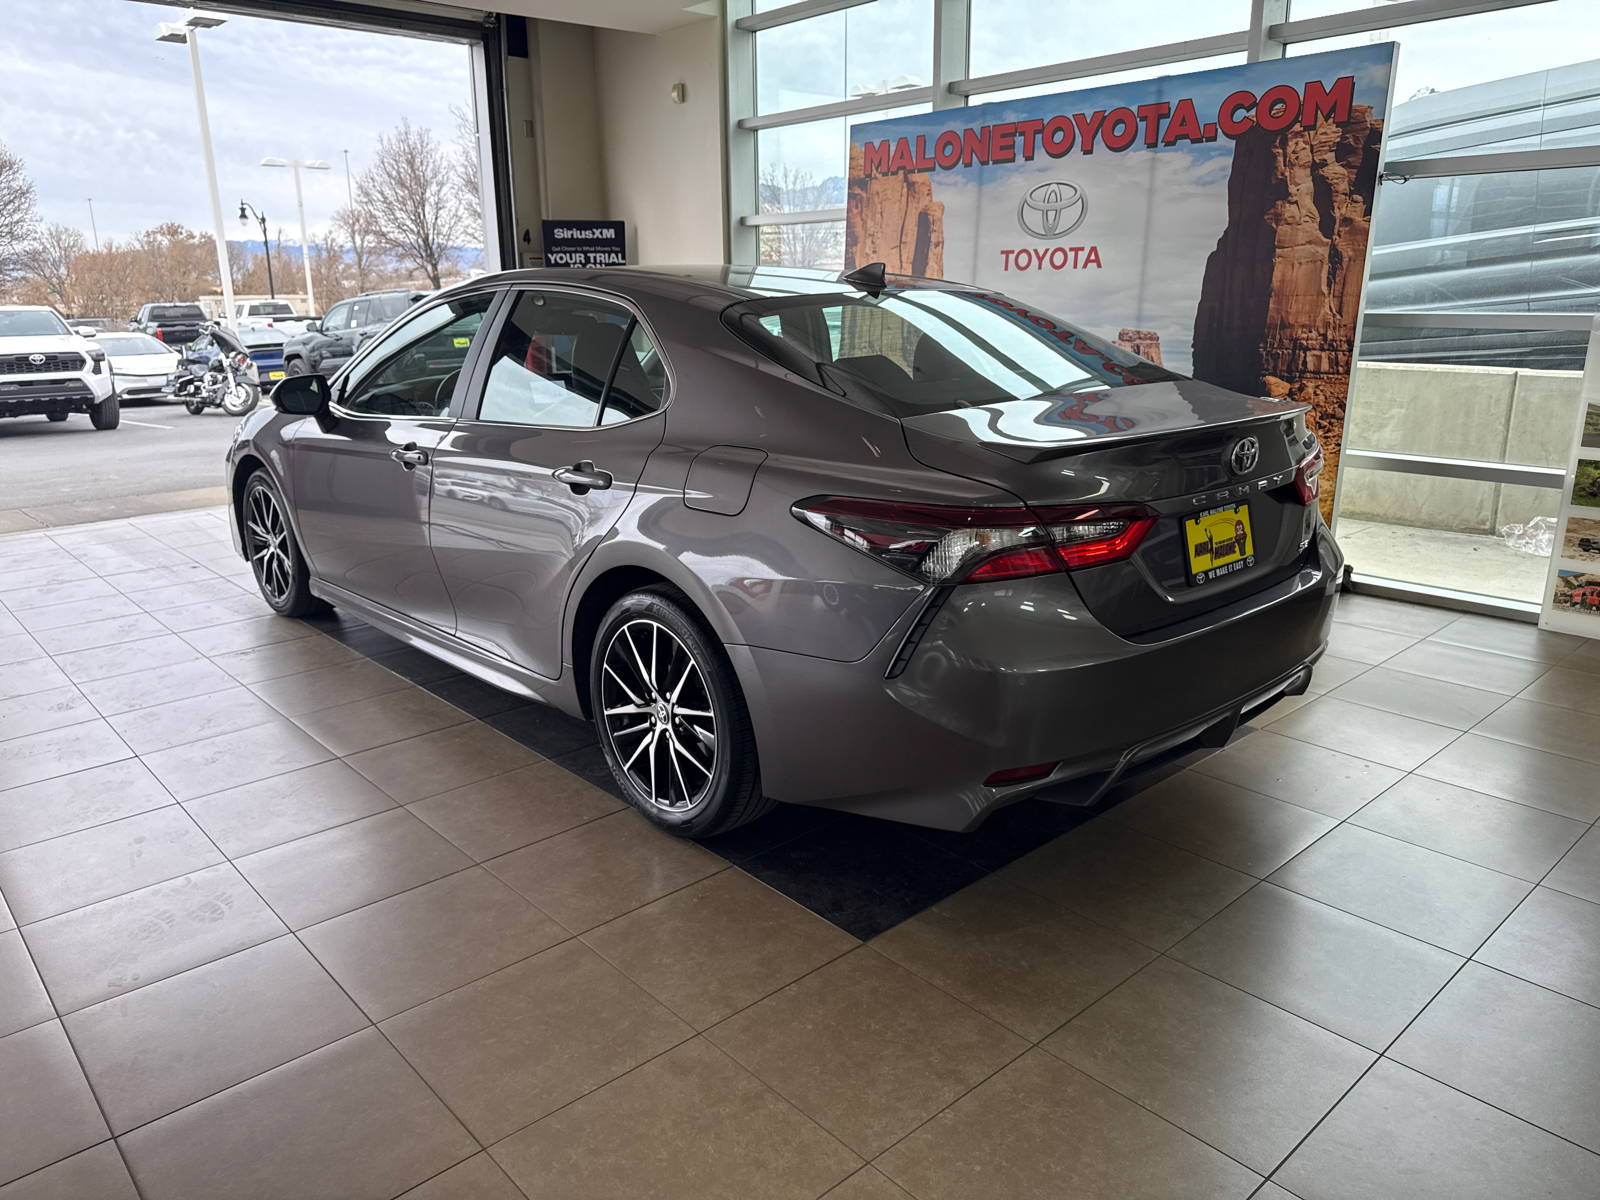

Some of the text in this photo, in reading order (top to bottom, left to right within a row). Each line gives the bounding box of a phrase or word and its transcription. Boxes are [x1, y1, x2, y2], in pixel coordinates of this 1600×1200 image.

[864, 76, 1355, 176] MALONETOYOTA.COM
[523, 229, 531, 245] 4
[553, 228, 616, 239] SiriusXM
[547, 253, 585, 264] YOUR
[587, 253, 626, 264] TRIAL
[1000, 246, 1102, 271] TOYOTA
[1236, 524, 1244, 535] 32
[1194, 540, 1211, 559] KARL
[1214, 541, 1237, 561] MALONE
[1208, 570, 1216, 579] WE
[1216, 565, 1229, 577] MAKE
[1233, 560, 1244, 571] EASY
